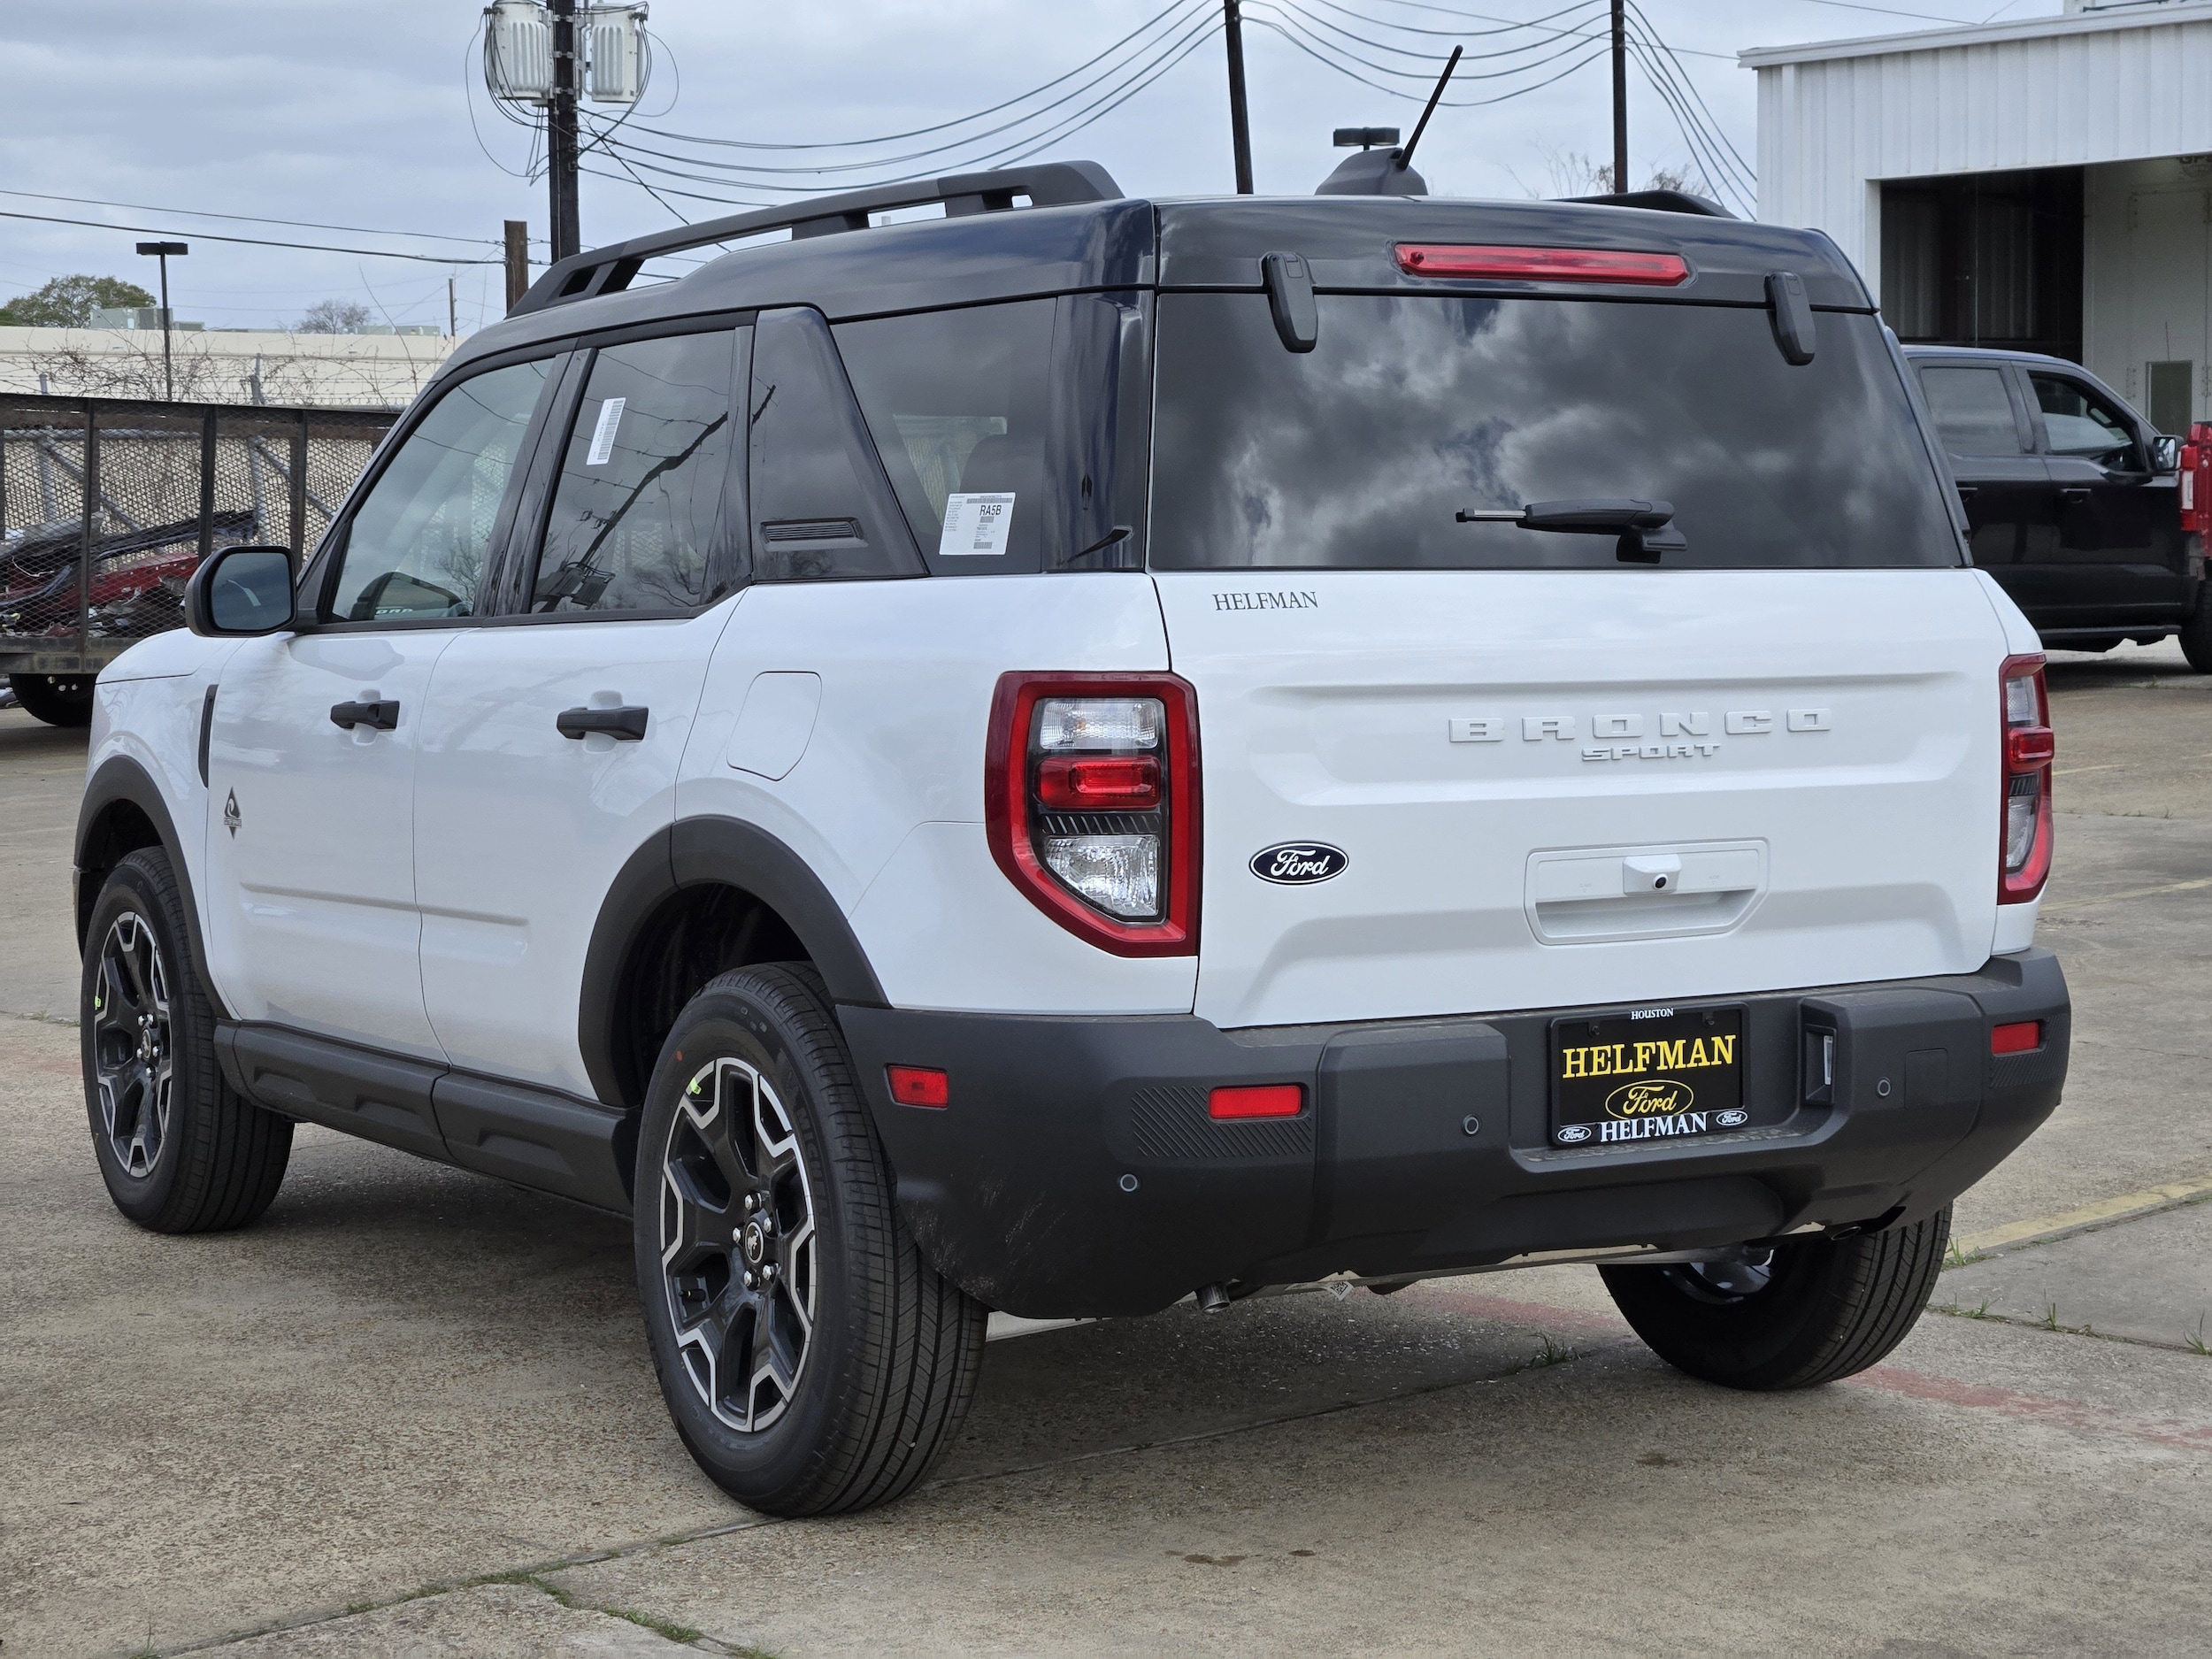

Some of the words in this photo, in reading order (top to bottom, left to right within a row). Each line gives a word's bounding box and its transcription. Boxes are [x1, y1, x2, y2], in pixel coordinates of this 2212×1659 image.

[979, 504, 1002, 516] RA5B
[1211, 591, 1319, 611] HELFMAN
[1448, 708, 1832, 743] BRONCO
[1580, 742, 1722, 762] SPORT
[1270, 849, 1332, 877] Ford
[1631, 1007, 1675, 1020] HOUSTON
[1562, 1034, 1737, 1079] HELFMAN
[1622, 1085, 1679, 1116] Ford
[1563, 1127, 1586, 1141] Ford
[1600, 1111, 1709, 1142] HELFMAN
[1720, 1111, 1743, 1125] Ford
